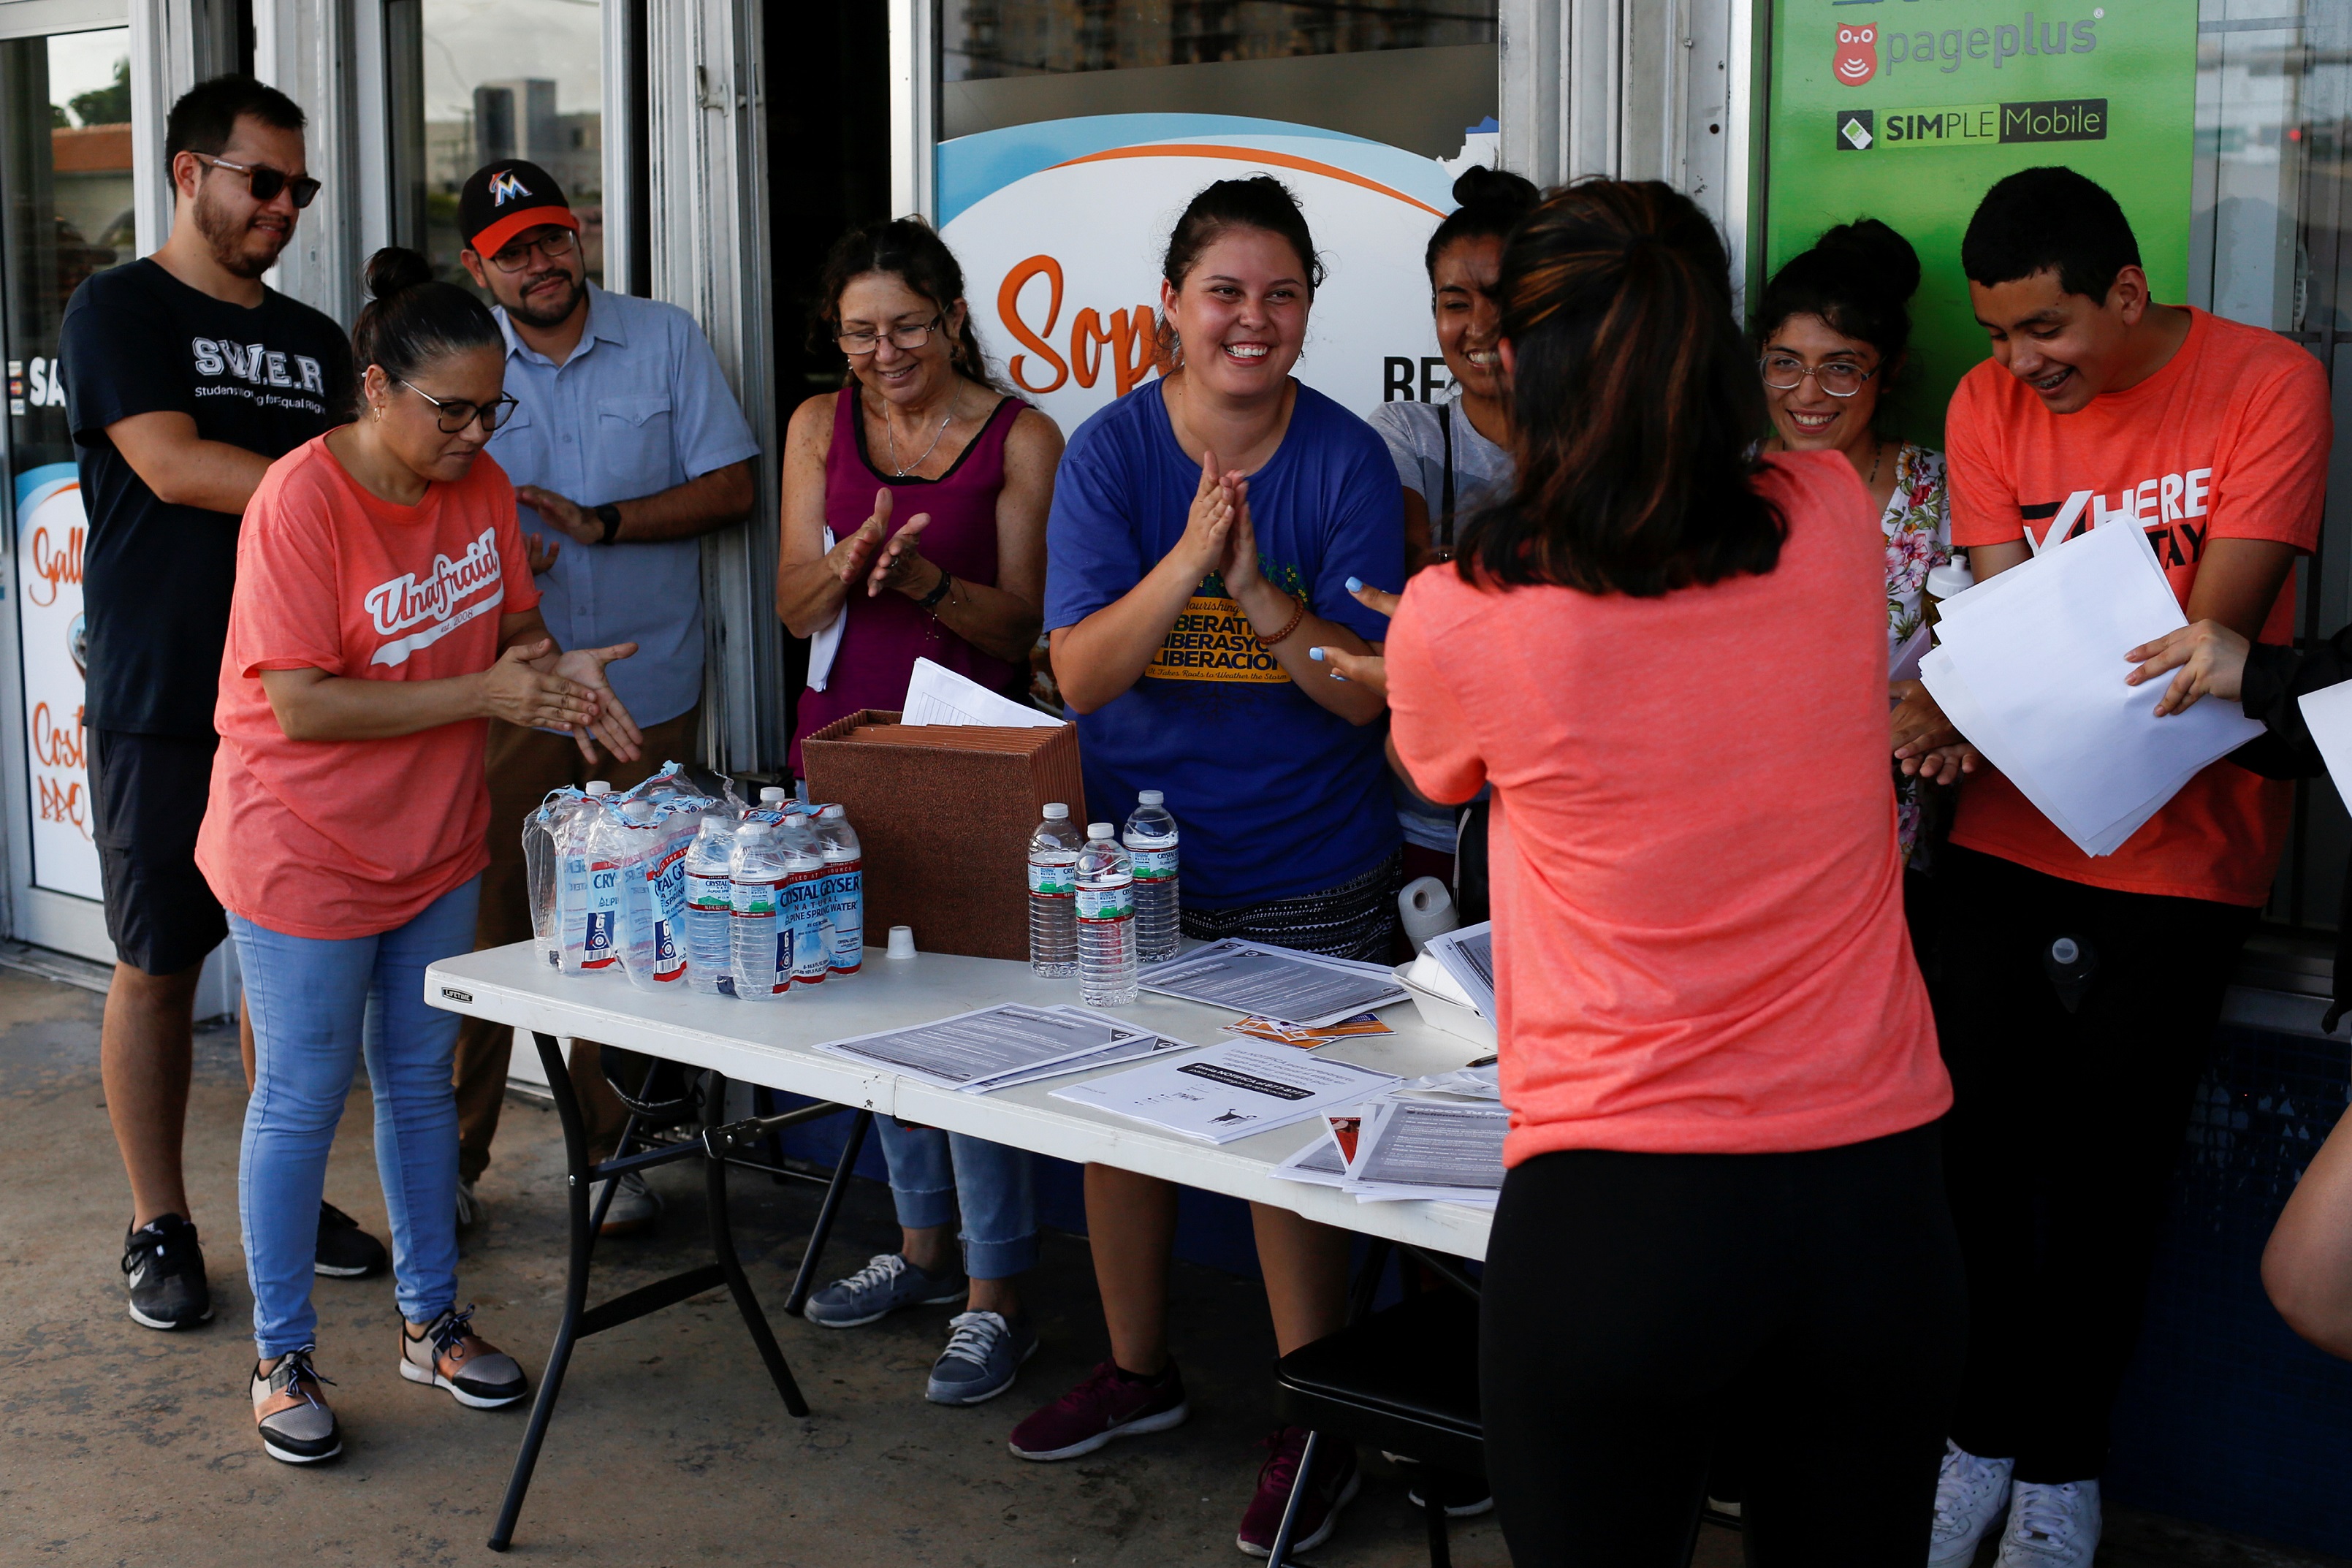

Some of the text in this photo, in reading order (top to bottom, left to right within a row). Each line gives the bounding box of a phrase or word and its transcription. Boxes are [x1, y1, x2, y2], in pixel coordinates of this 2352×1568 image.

[1886, 12, 2097, 75] pageplus
[1887, 105, 2101, 141] SIMPLE Mobile
[997, 254, 1182, 399] Sop
[2146, 522, 2206, 570] TAY
[371, 536, 498, 630] Unafraid
[453, 608, 473, 627] 2008
[1185, 600, 1241, 617] lourishing
[1171, 614, 1252, 635] BERATI
[1161, 633, 1270, 652] IBERASYO
[1158, 669, 1180, 677] Takes
[1182, 669, 1204, 678] Roots
[1215, 671, 1249, 680] Weather
[1251, 672, 1262, 680] the
[1263, 672, 1287, 680] Storm
[827, 866, 852, 874] SOURCE
[820, 875, 861, 897] GEYSER
[794, 895, 838, 911] NATURAL
[806, 905, 830, 920] SPRING
[830, 901, 857, 912] WATER
[663, 918, 670, 938] 6
[784, 931, 790, 948] 6
[446, 989, 470, 1001] LIFETIME
[1217, 1070, 1257, 1084] NOTIFICA
[1404, 1105, 1461, 1114] Conoce
